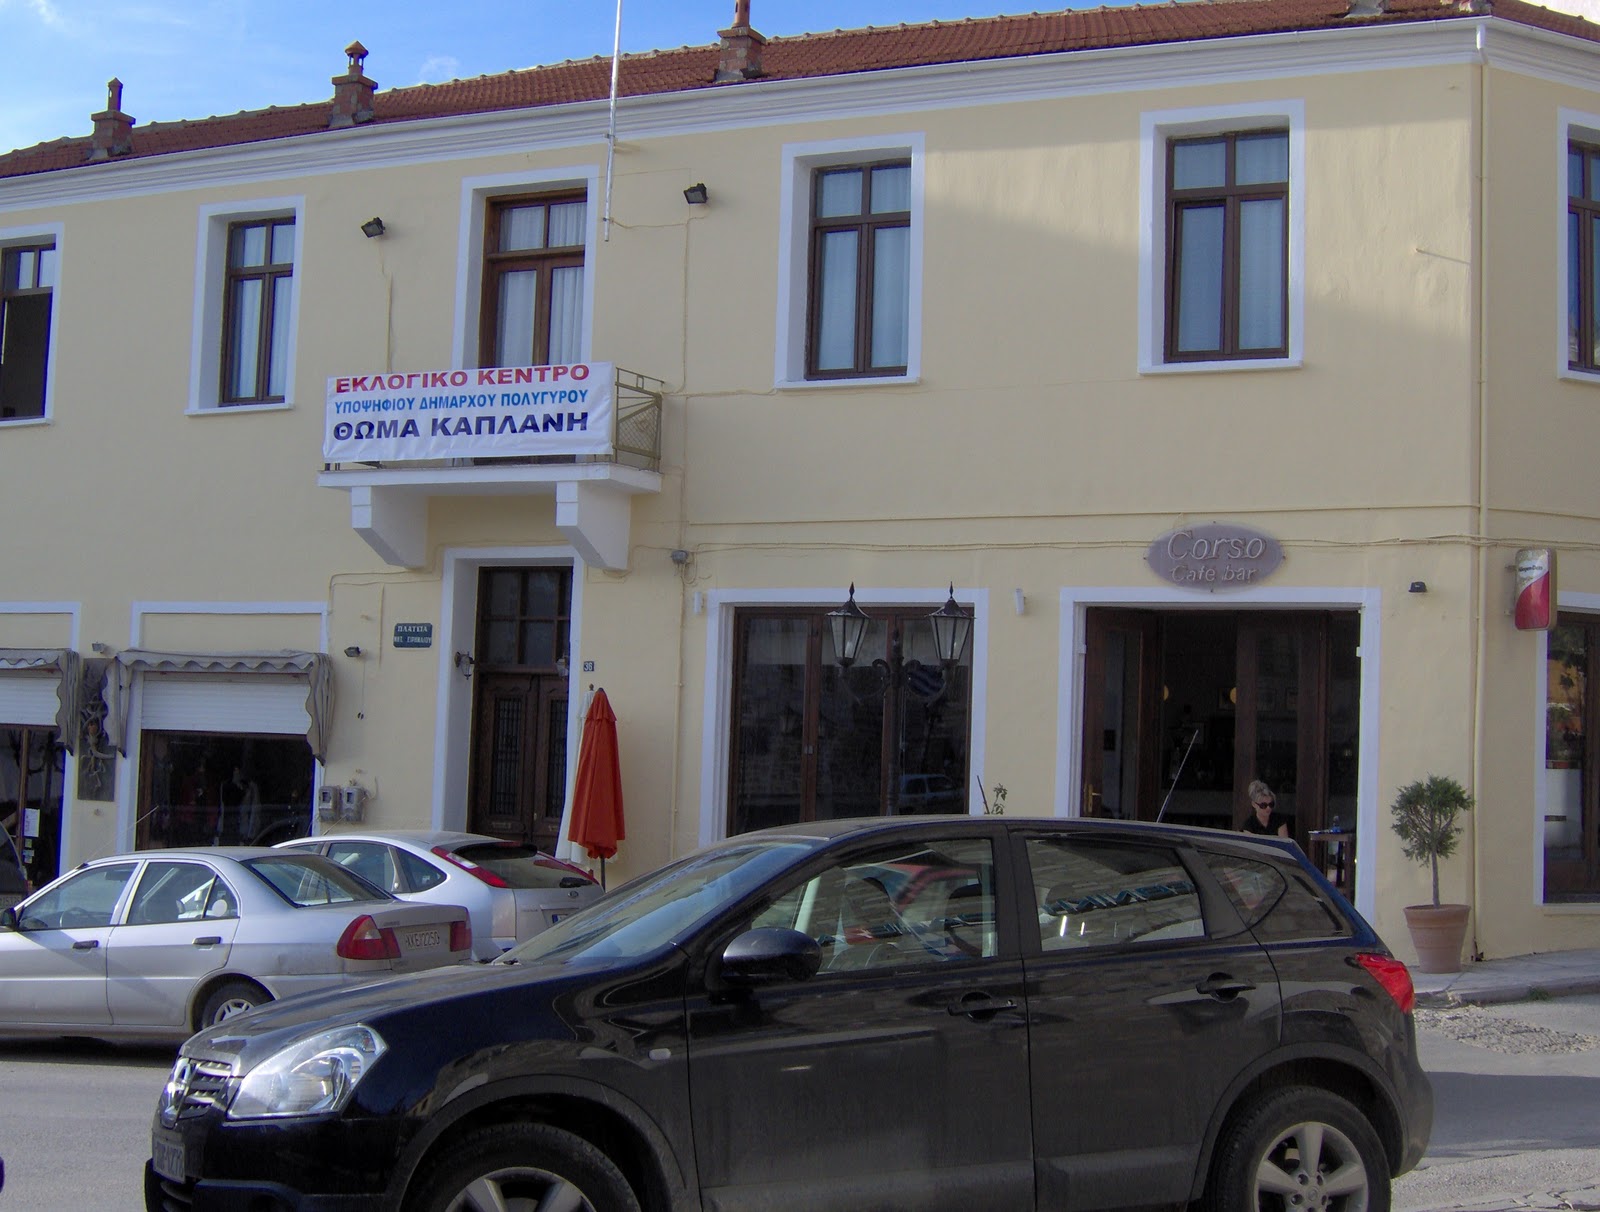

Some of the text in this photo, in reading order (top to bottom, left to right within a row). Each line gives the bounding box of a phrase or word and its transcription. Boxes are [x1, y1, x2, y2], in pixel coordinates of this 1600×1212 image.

[336, 364, 590, 393] ΕΚΛΟΓΙΚΟ ΚΕΝΤΡΟ
[334, 389, 589, 414] ΥΠΟΨΗΦΙΟΥ ΔΗΜΑΡΧΟΥ ΠΟΛΥΓΥΡΟΥ
[333, 412, 589, 441] ΘΩΜΑ ΚΑΠΛΑΝΗ
[1167, 531, 1265, 560] Corso
[1171, 563, 1257, 582] Cafe bar
